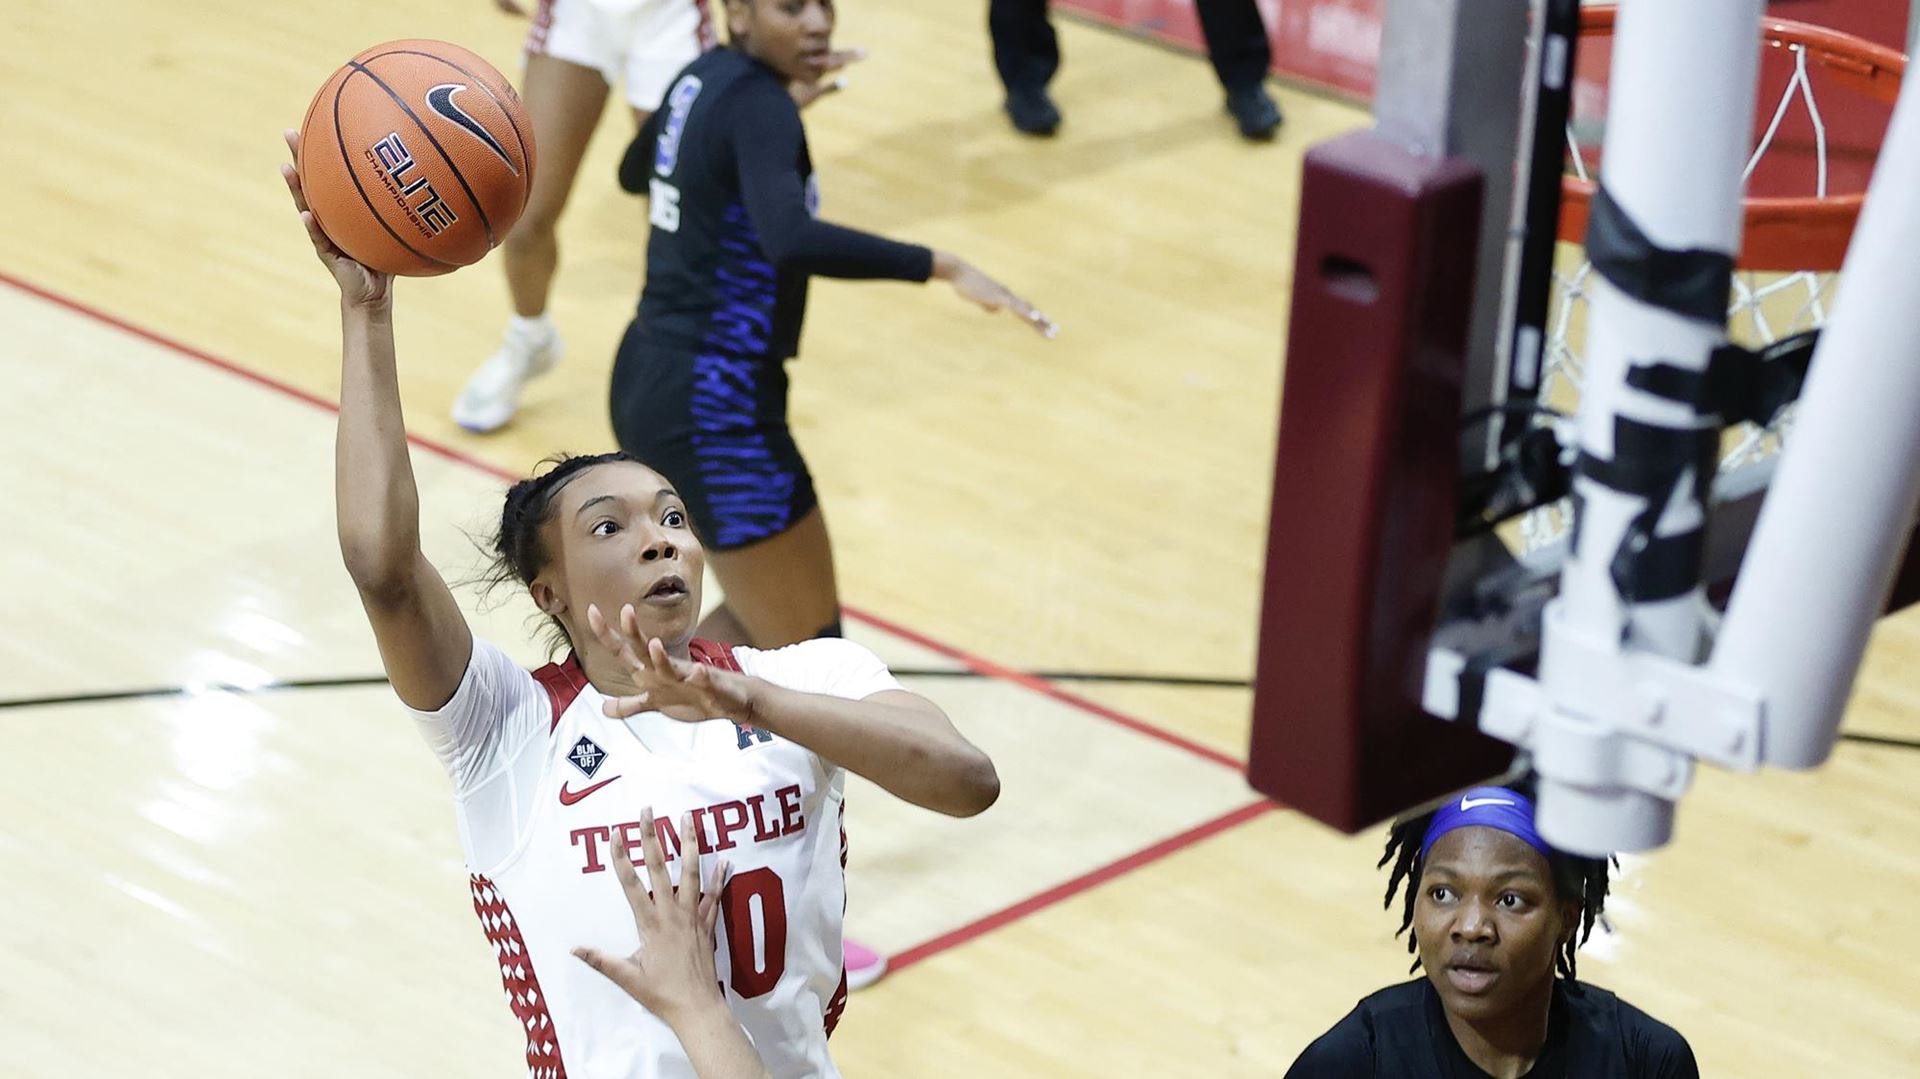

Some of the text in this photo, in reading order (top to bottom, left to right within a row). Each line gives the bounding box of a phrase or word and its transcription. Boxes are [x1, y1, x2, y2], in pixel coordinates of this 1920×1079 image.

[364, 150, 434, 240] CHAMPIONSHIP
[372, 132, 459, 236] ELITE
[576, 743, 596, 756] BLM
[580, 757, 596, 768] OFJ
